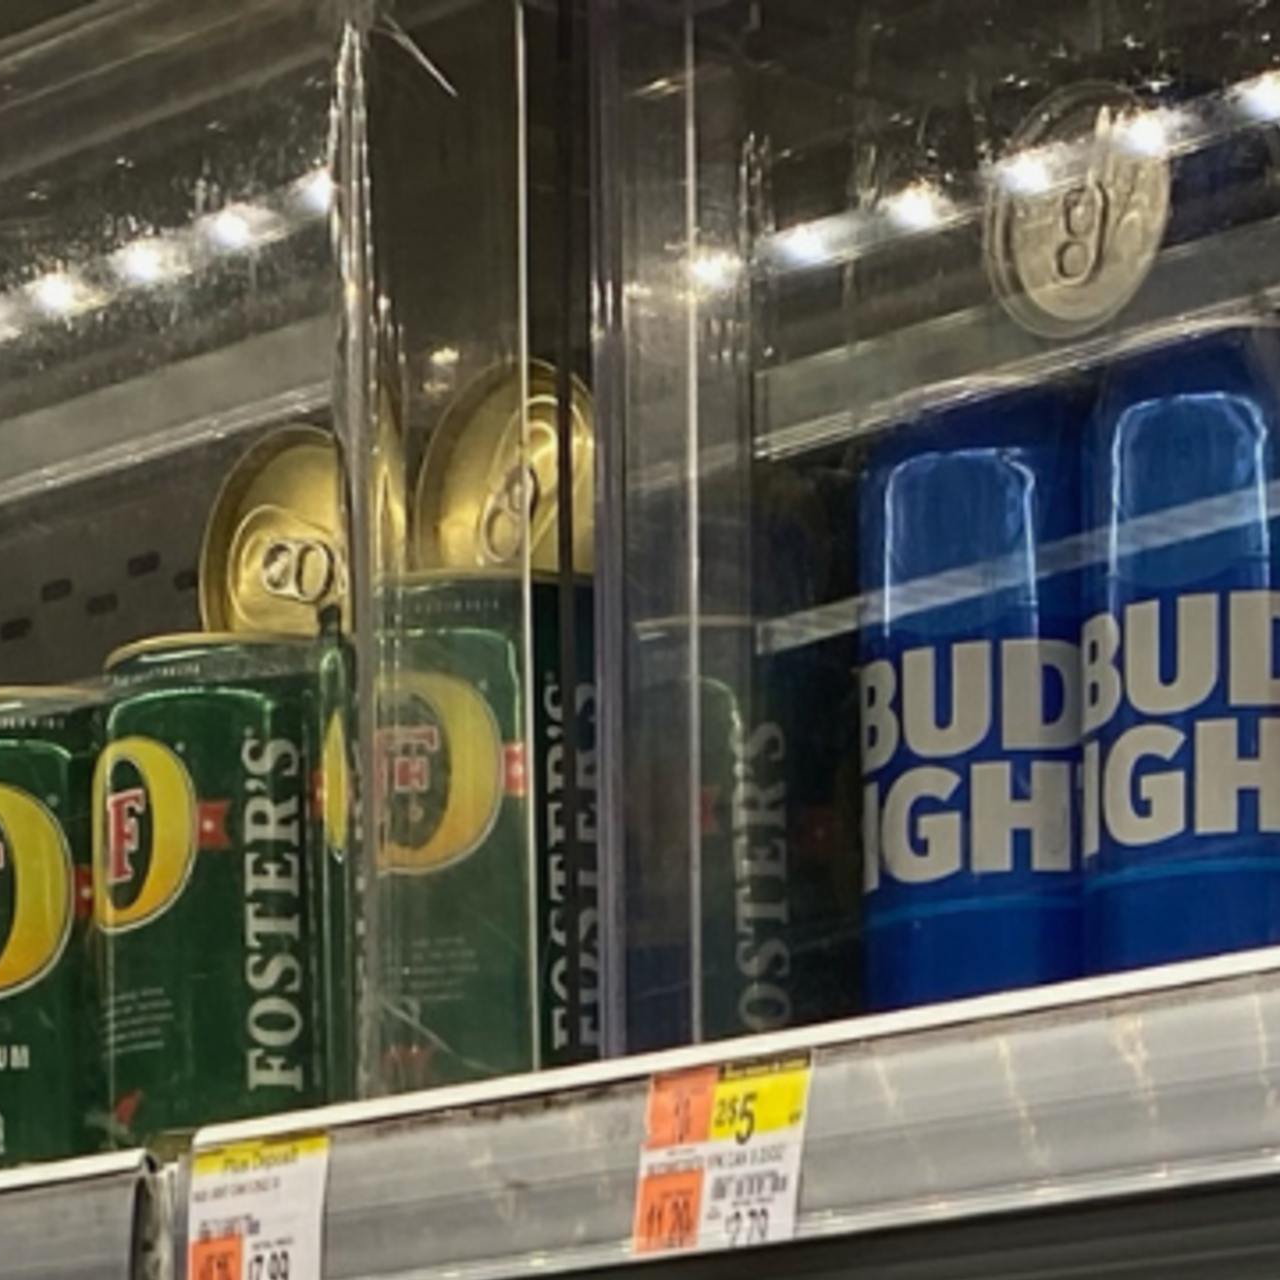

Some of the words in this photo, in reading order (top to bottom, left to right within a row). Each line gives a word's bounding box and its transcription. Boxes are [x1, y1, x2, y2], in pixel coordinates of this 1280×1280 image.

[860, 638, 1084, 778] BUD
[107, 788, 145, 884] F
[243, 730, 305, 1093] FOSTER'S
